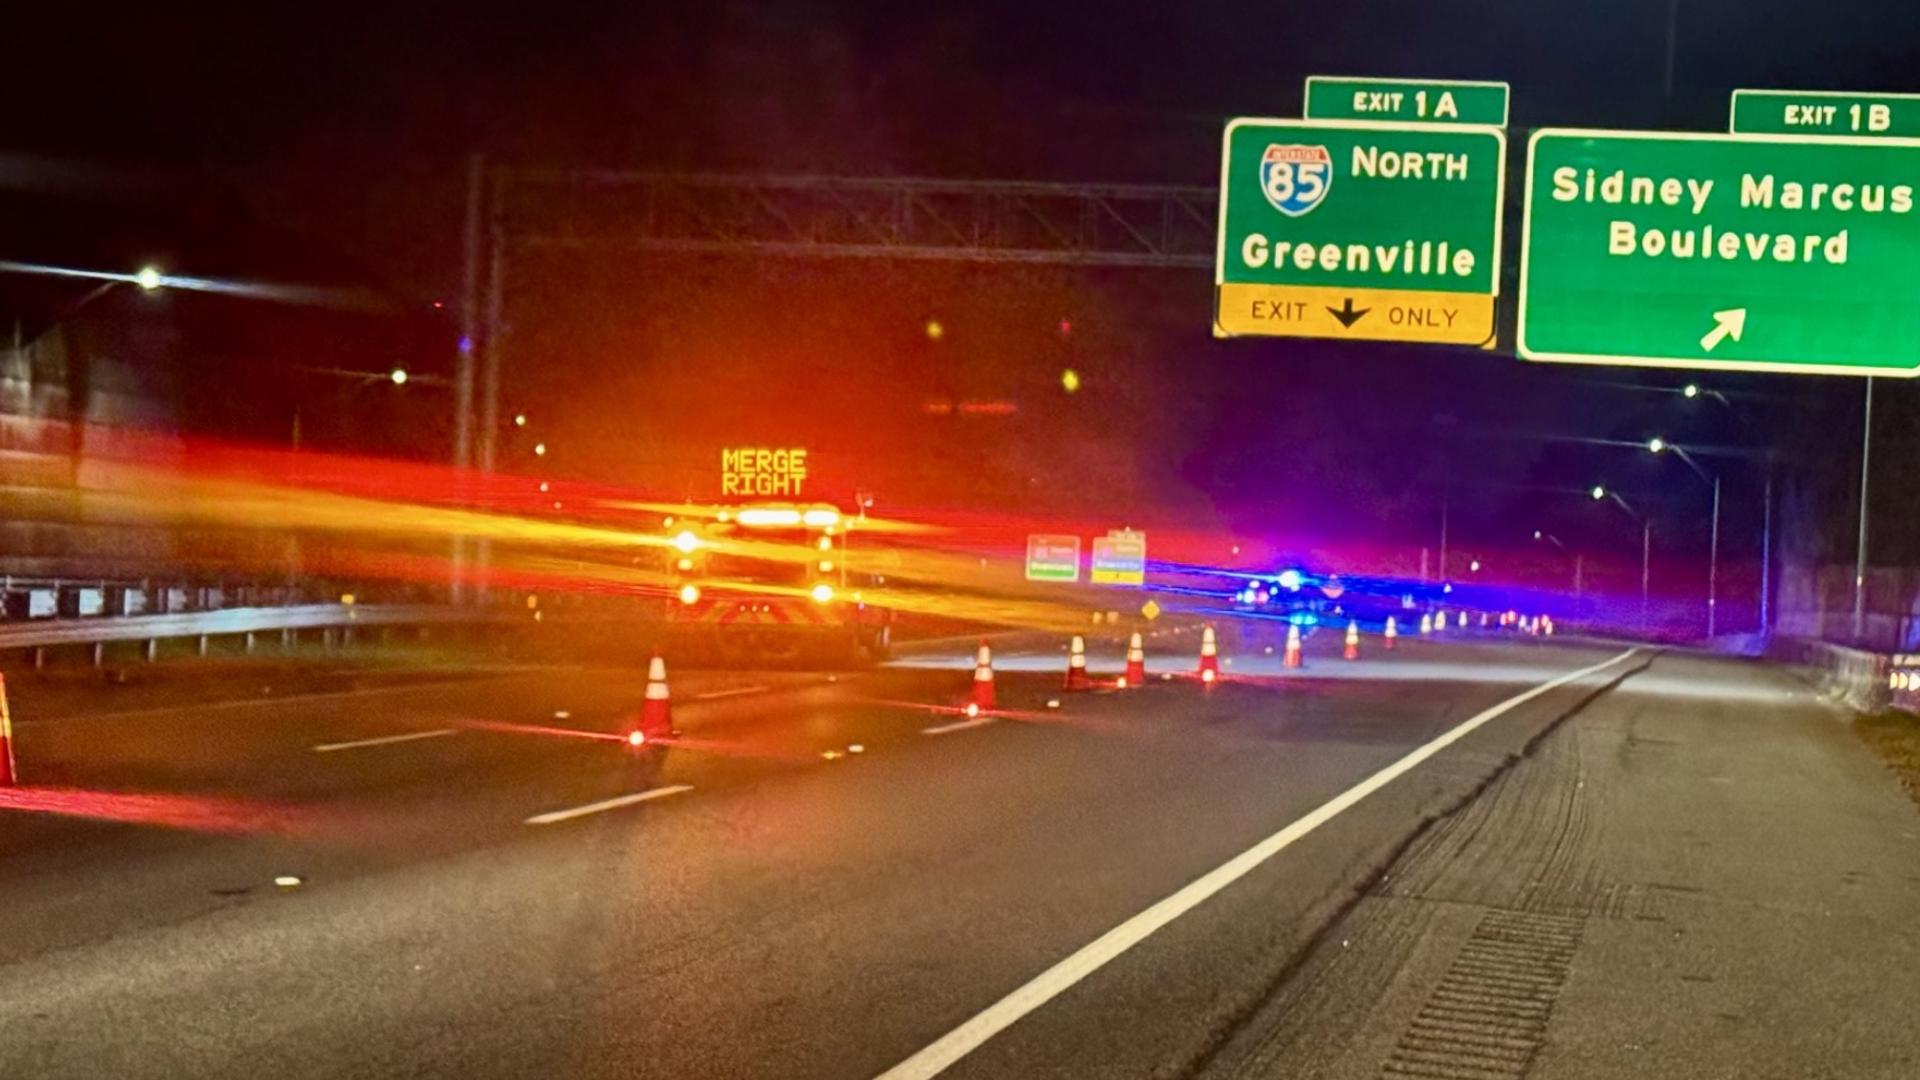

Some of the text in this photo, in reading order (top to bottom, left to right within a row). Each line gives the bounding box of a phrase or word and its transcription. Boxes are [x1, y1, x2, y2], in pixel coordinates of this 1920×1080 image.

[1353, 91, 1403, 112] EXIT
[1784, 104, 1837, 126] EXIT
[1351, 145, 1468, 181] NORTH
[1267, 162, 1325, 202] 85
[1552, 166, 1914, 215] Sidney Marcus
[1241, 232, 1476, 277] Greenville
[1608, 220, 1848, 264] Boulevard
[1251, 300, 1459, 328] EXIT ONLY
[722, 449, 807, 473] MERGE
[722, 473, 806, 496] RIGHT
